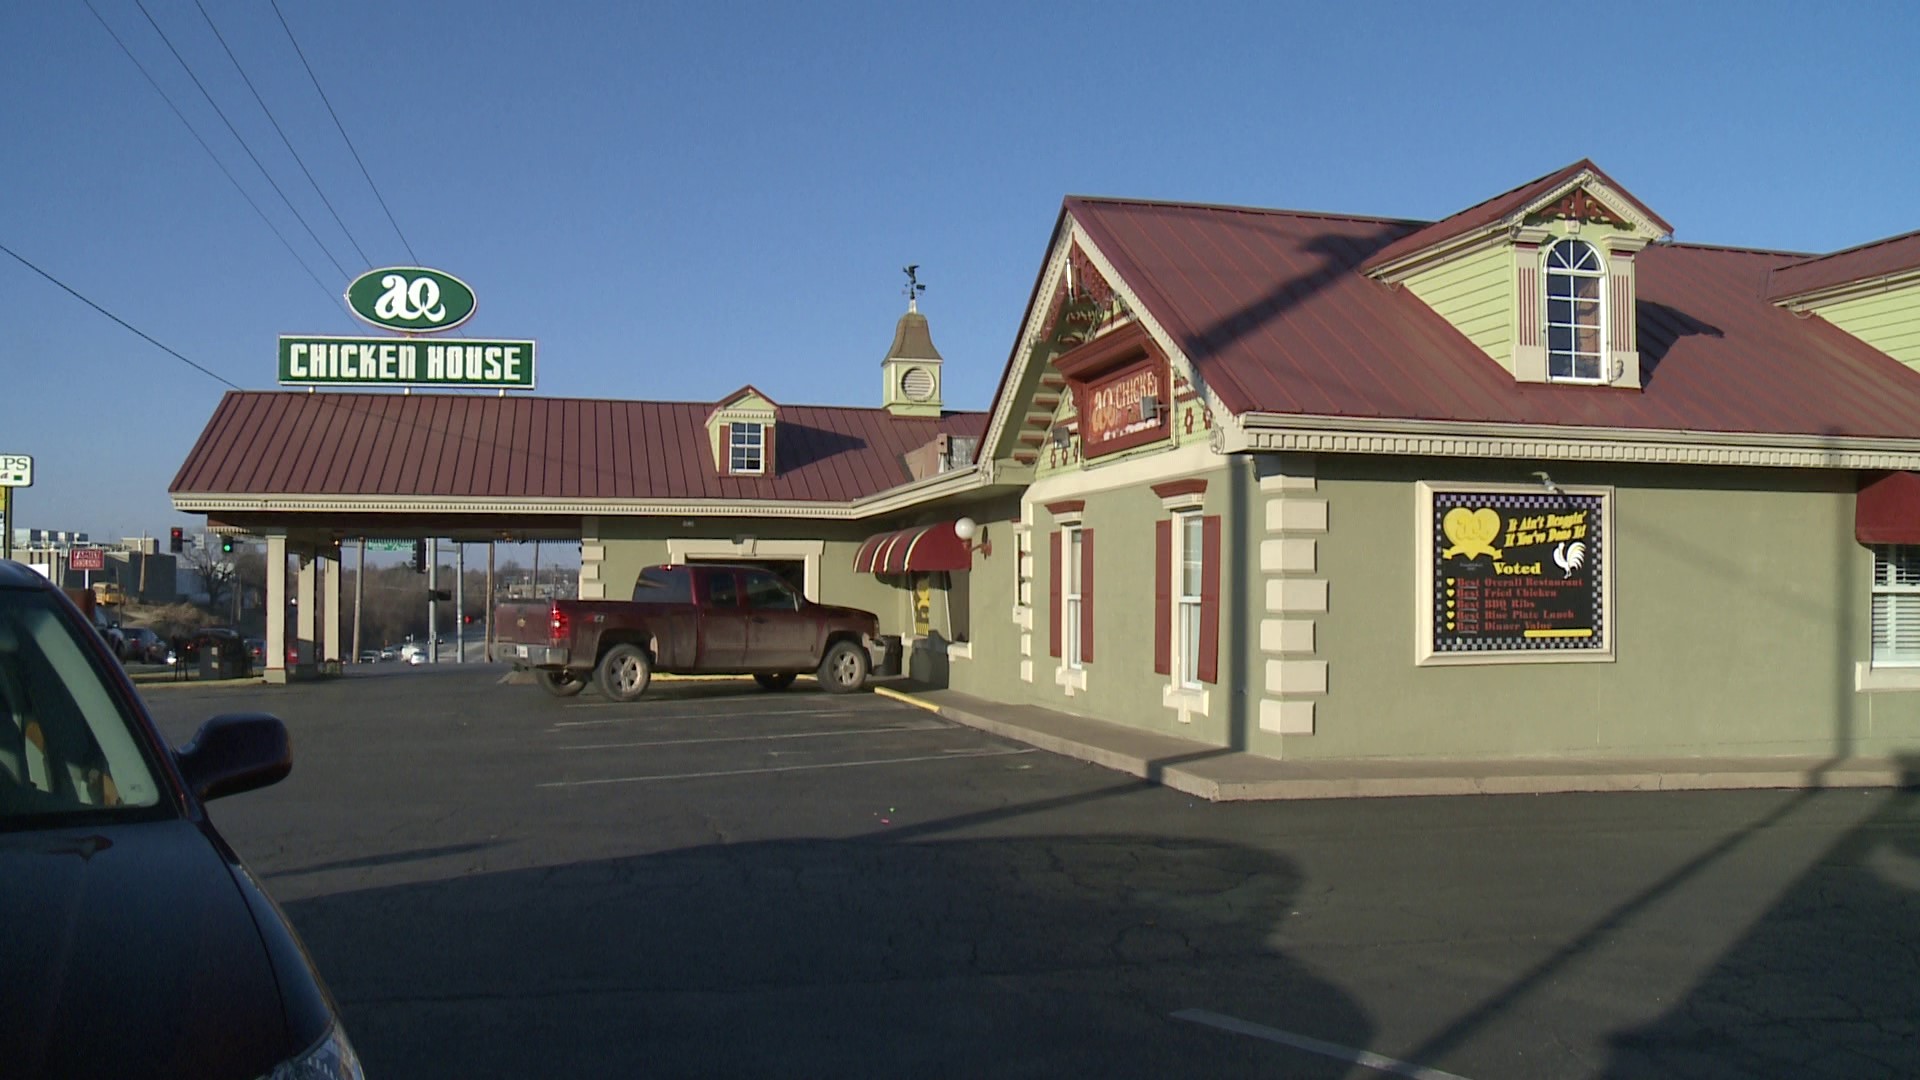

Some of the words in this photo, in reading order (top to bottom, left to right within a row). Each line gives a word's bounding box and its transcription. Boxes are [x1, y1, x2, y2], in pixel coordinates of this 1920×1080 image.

[290, 343, 416, 379] CHICKEN
[427, 344, 521, 381] HOUSE
[0, 457, 27, 471] PS
[1507, 518, 1518, 532] It
[1519, 515, 1545, 531] Ain't
[1516, 530, 1546, 546] You've
[1547, 528, 1572, 542] Done
[1493, 561, 1542, 575] Voted
[1457, 578, 1480, 587] Best
[1485, 578, 1522, 587] Overall
[1526, 578, 1584, 587] Restaurant
[1457, 589, 1480, 598] Best
[1485, 589, 1512, 598] Fried
[1517, 589, 1557, 598] Chicken
[1457, 600, 1480, 609] Best
[1485, 600, 1507, 610] BBQ
[1512, 600, 1535, 608] Ribs
[1457, 611, 1480, 619] Best
[1485, 611, 1507, 619] Blue
[1513, 611, 1538, 619] Plate
[1543, 611, 1575, 619] Lunch
[1457, 622, 1480, 630] Best
[1485, 622, 1520, 630] Dinner
[1525, 621, 1552, 630] Value
